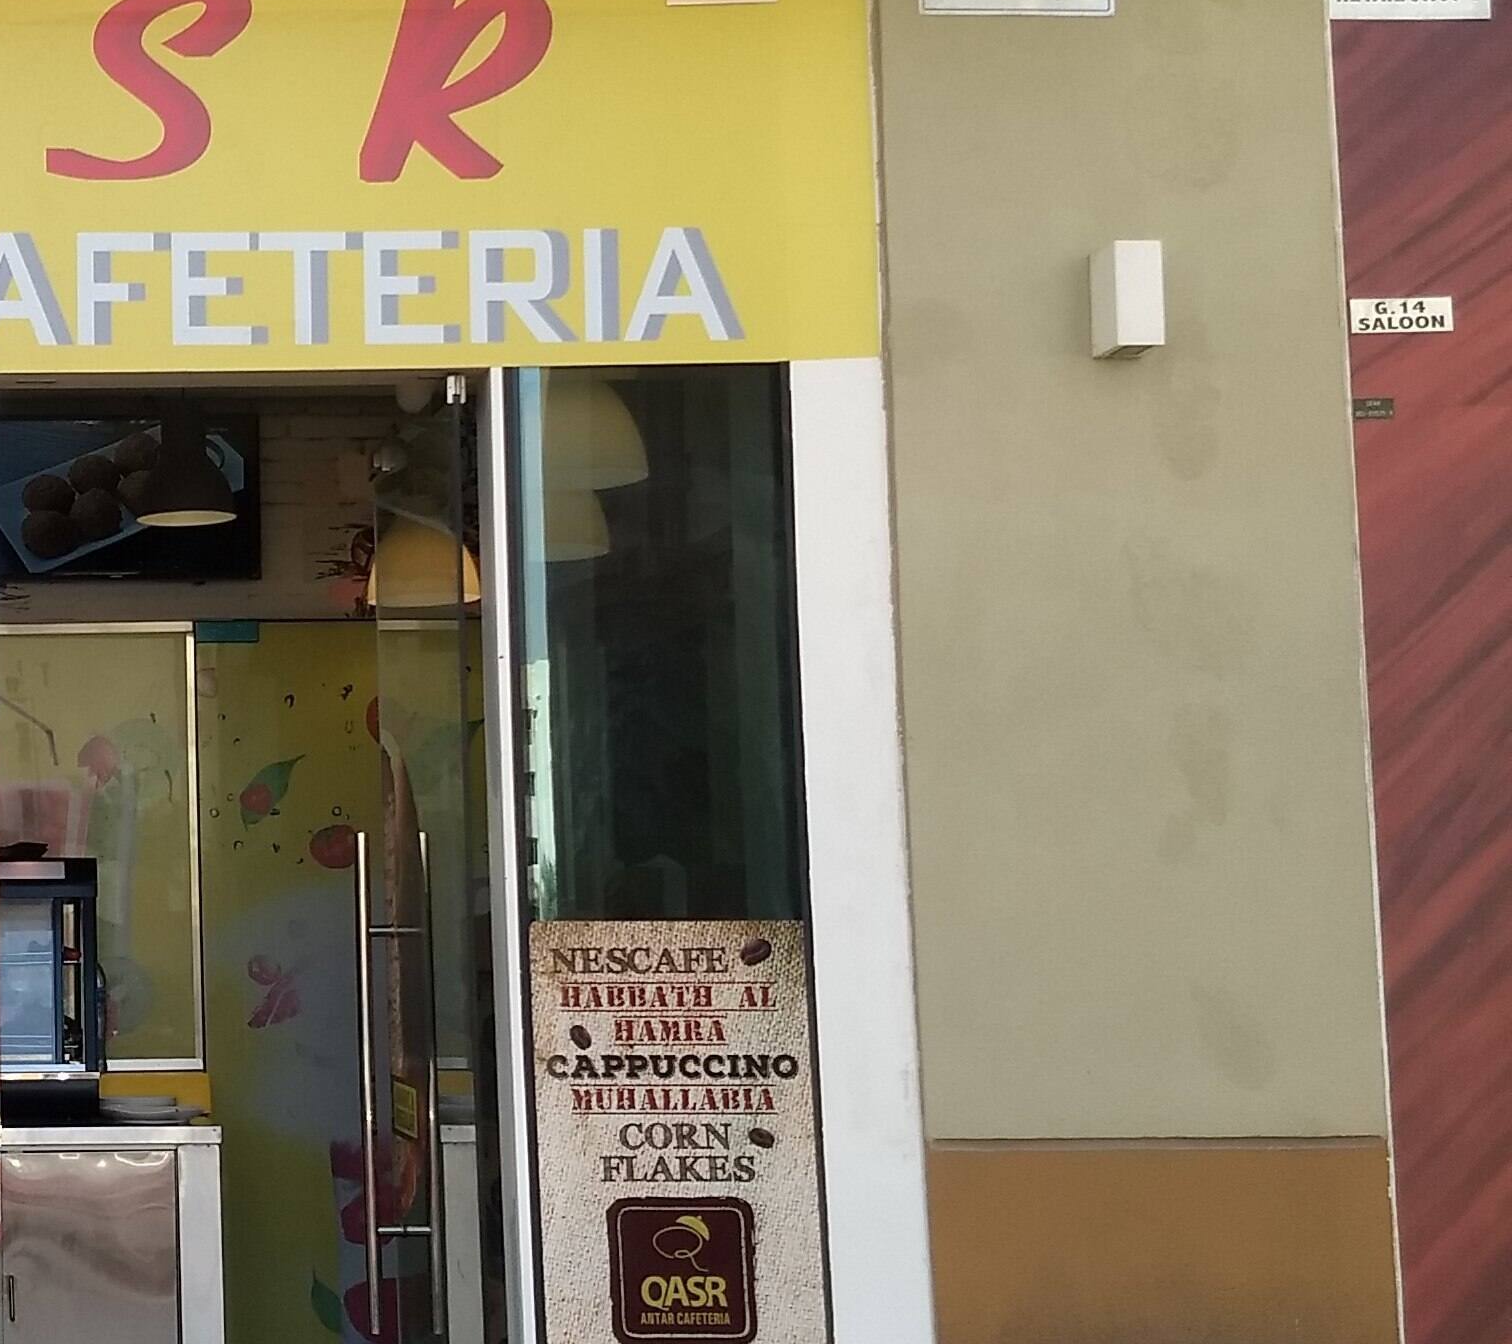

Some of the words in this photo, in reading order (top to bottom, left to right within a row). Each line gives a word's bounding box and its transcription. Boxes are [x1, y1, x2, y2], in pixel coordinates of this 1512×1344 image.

[1374, 300, 1426, 315] G.14
[1358, 314, 1446, 332] SALOON
[548, 947, 729, 974] NESCAFE
[560, 986, 713, 1008] HABBATH
[739, 986, 778, 1008] AL
[614, 1019, 727, 1042] HAMRA
[546, 1054, 800, 1079] CAPPUCCINO
[571, 1088, 776, 1111] MUHALLABIA
[619, 1122, 732, 1151] CORN
[600, 1155, 756, 1182] FLAKES
[640, 1276, 728, 1311] QASR
[640, 1312, 675, 1325] ANTAR
[676, 1312, 731, 1325] CAFETERIA
